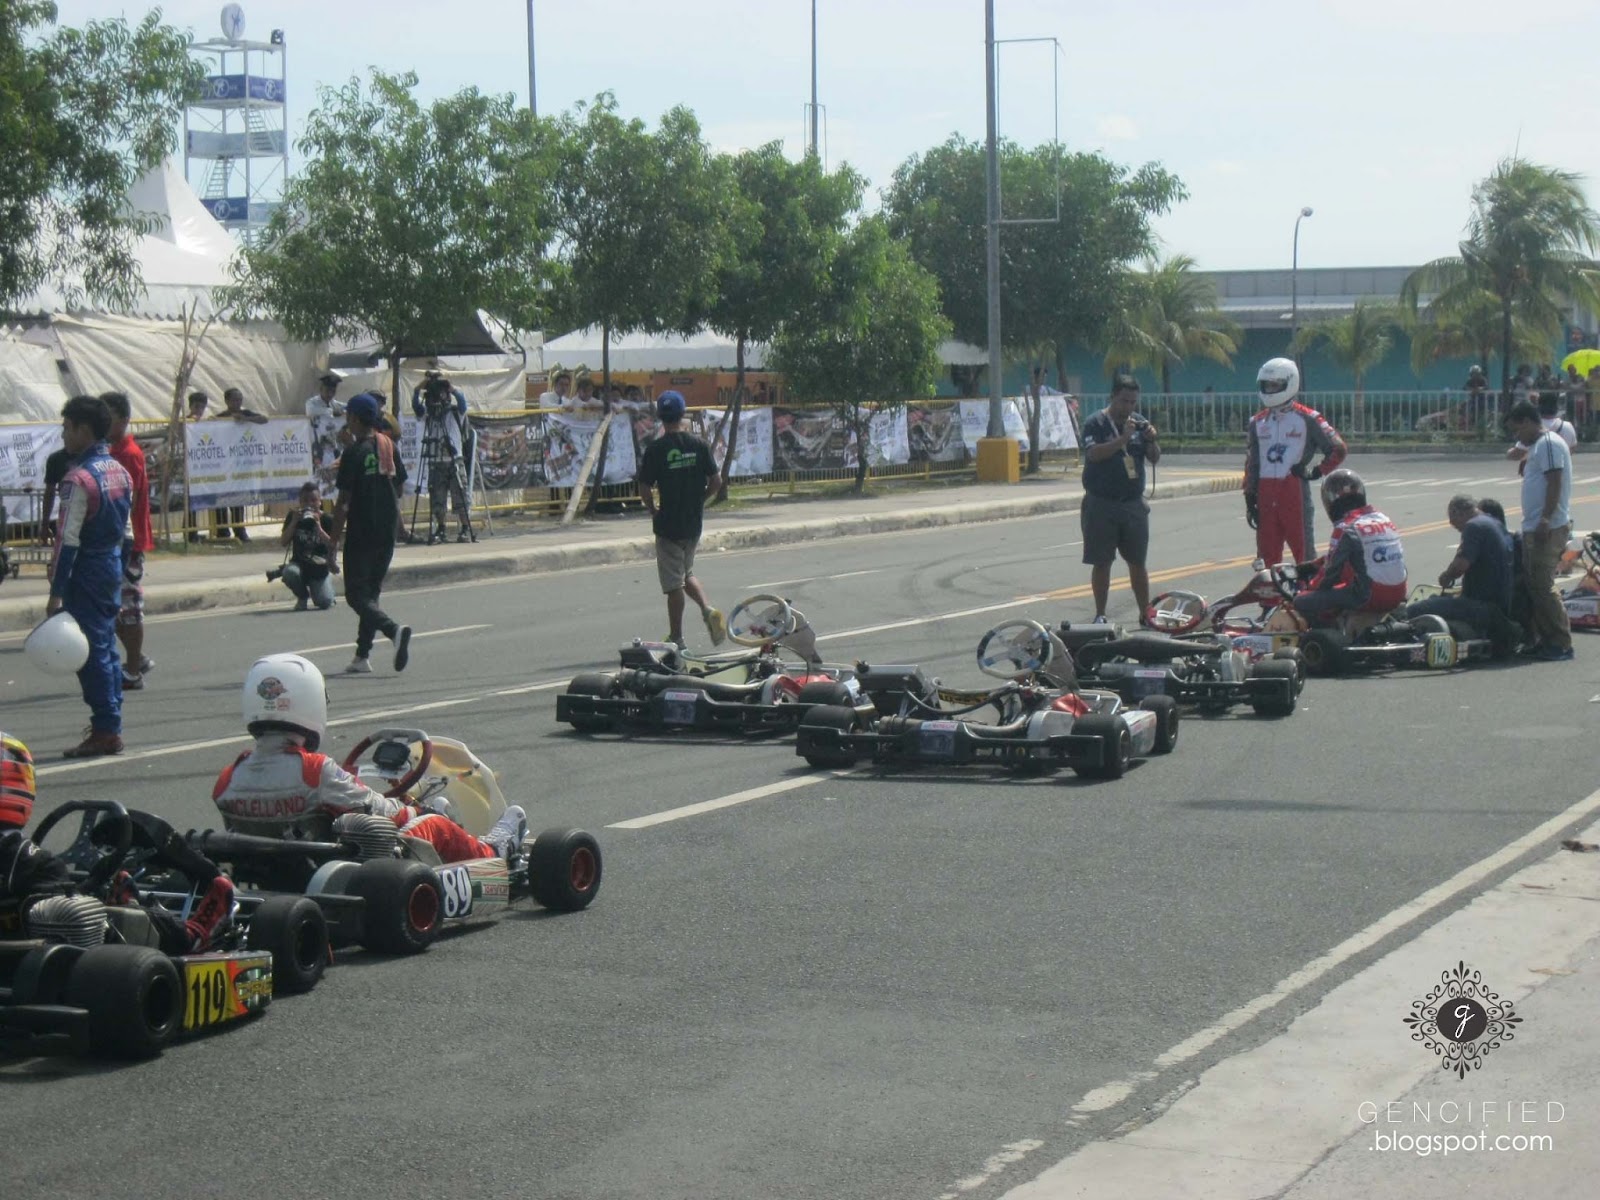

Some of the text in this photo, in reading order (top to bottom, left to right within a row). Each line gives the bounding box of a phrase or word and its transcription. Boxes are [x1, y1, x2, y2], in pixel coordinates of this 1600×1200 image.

[187, 442, 308, 461] MICROTEL MICROTEL MICROTEL
[442, 867, 473, 918] 89
[190, 969, 226, 1030] 119
